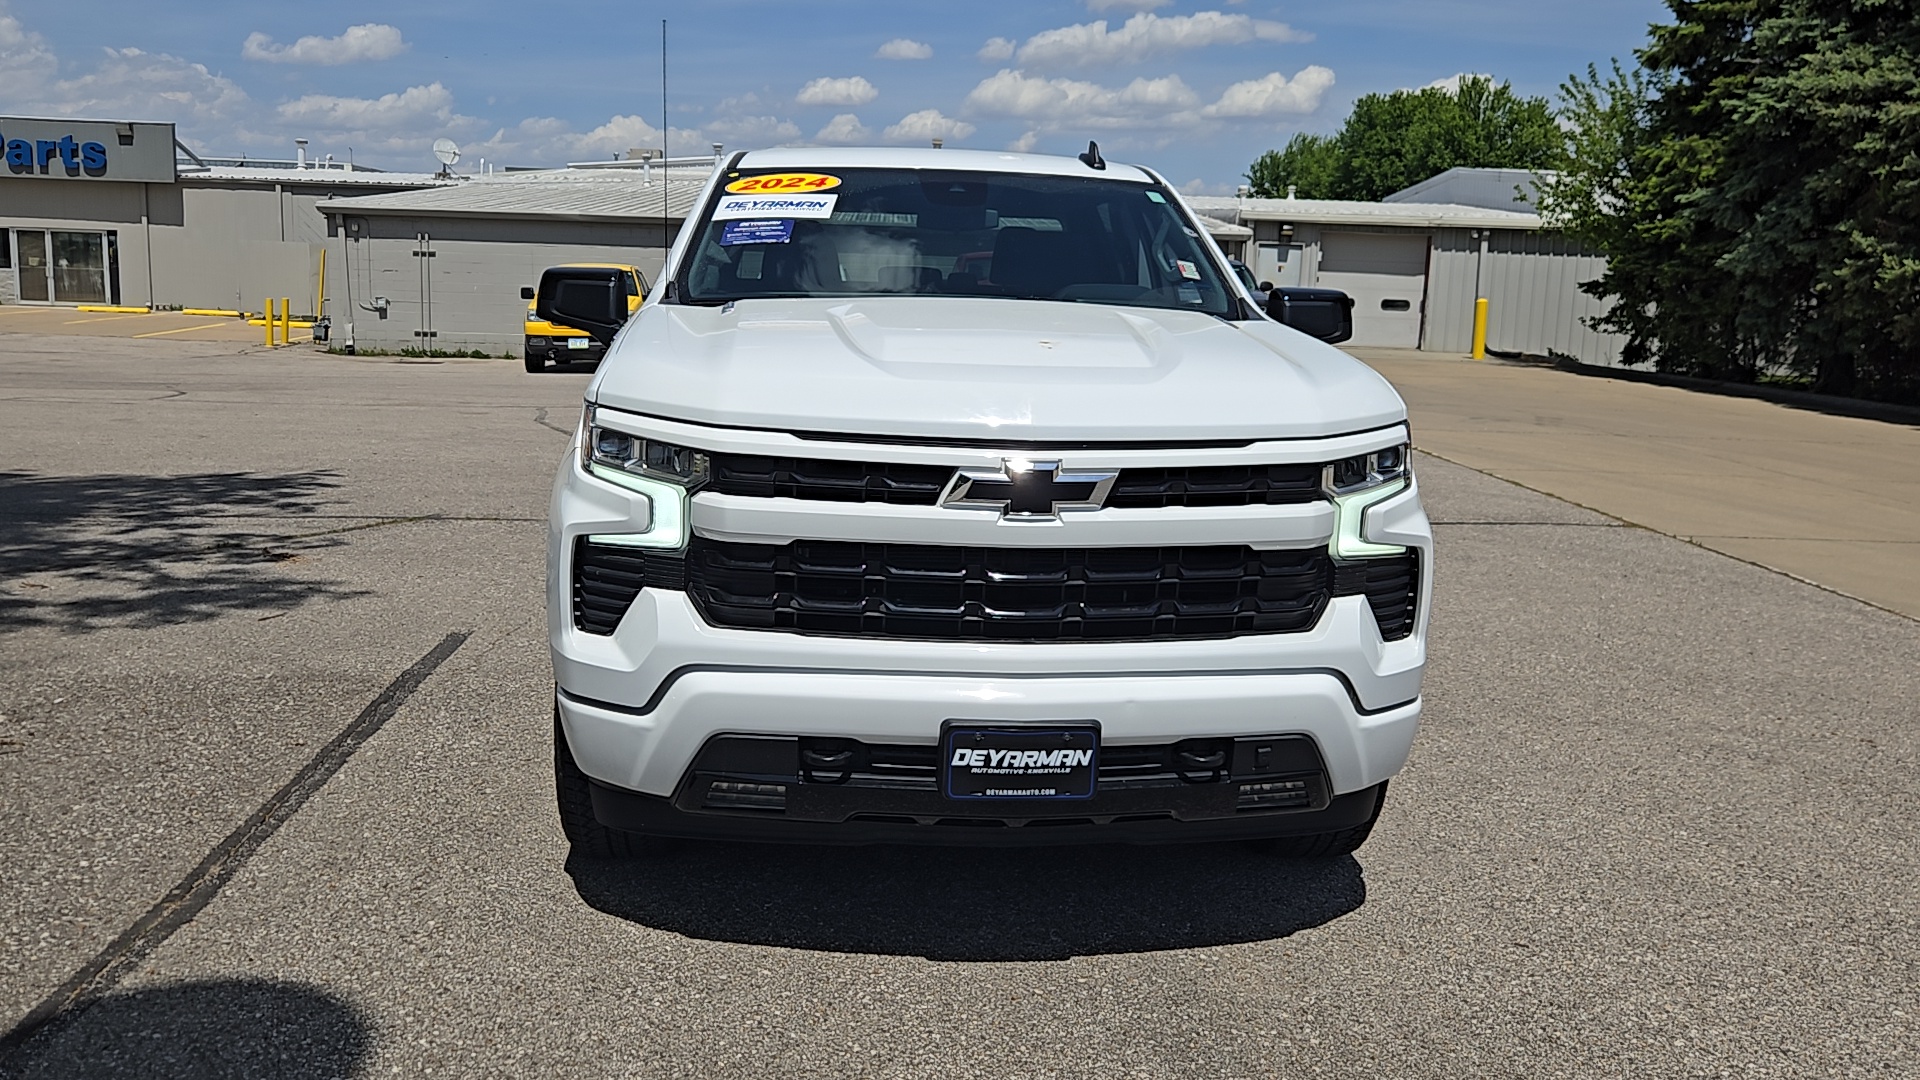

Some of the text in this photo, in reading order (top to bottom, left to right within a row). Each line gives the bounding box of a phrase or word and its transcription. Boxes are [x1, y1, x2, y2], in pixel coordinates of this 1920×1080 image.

[0, 134, 107, 170] arts
[736, 177, 829, 191] 2024
[725, 200, 828, 209] DEYARMAN
[951, 749, 1093, 767] DEYARMAN
[986, 788, 1056, 796] DEYARMANAUTO.COM
